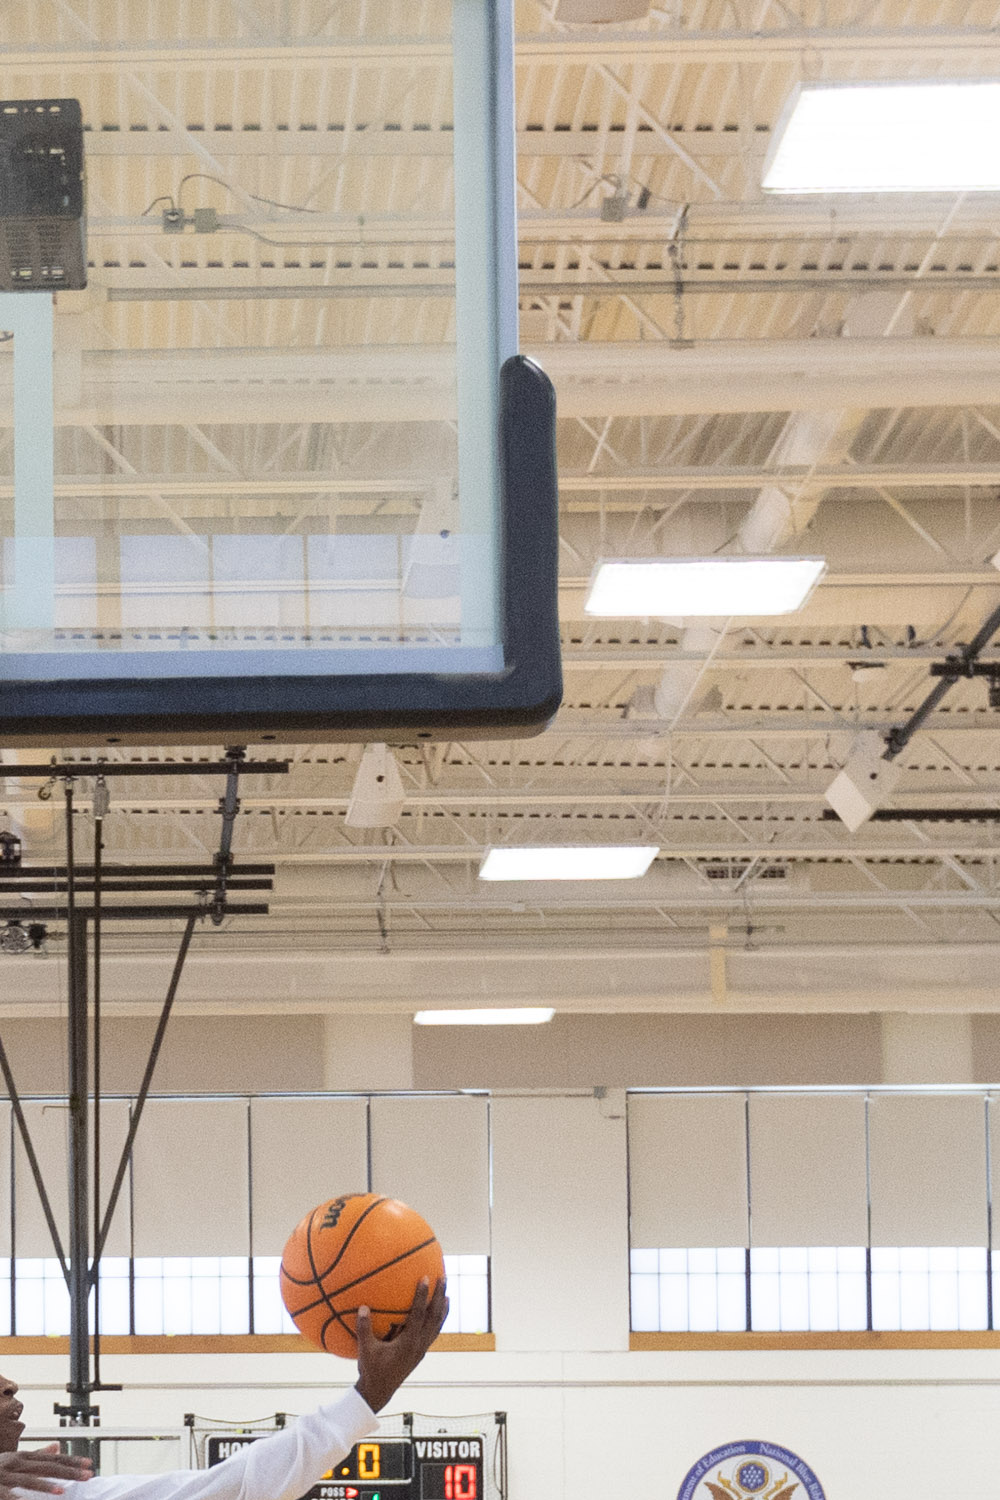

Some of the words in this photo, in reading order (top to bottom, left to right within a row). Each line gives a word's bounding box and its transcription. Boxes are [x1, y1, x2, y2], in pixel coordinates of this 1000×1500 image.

[415, 1441, 481, 1458] VISITOR
[694, 1463, 705, 1476] of
[702, 1445, 746, 1468] Education
[760, 1442, 799, 1466] National
[795, 1462, 812, 1483] Blue
[320, 1487, 345, 1497] POSS
[445, 1464, 477, 1500] 10
